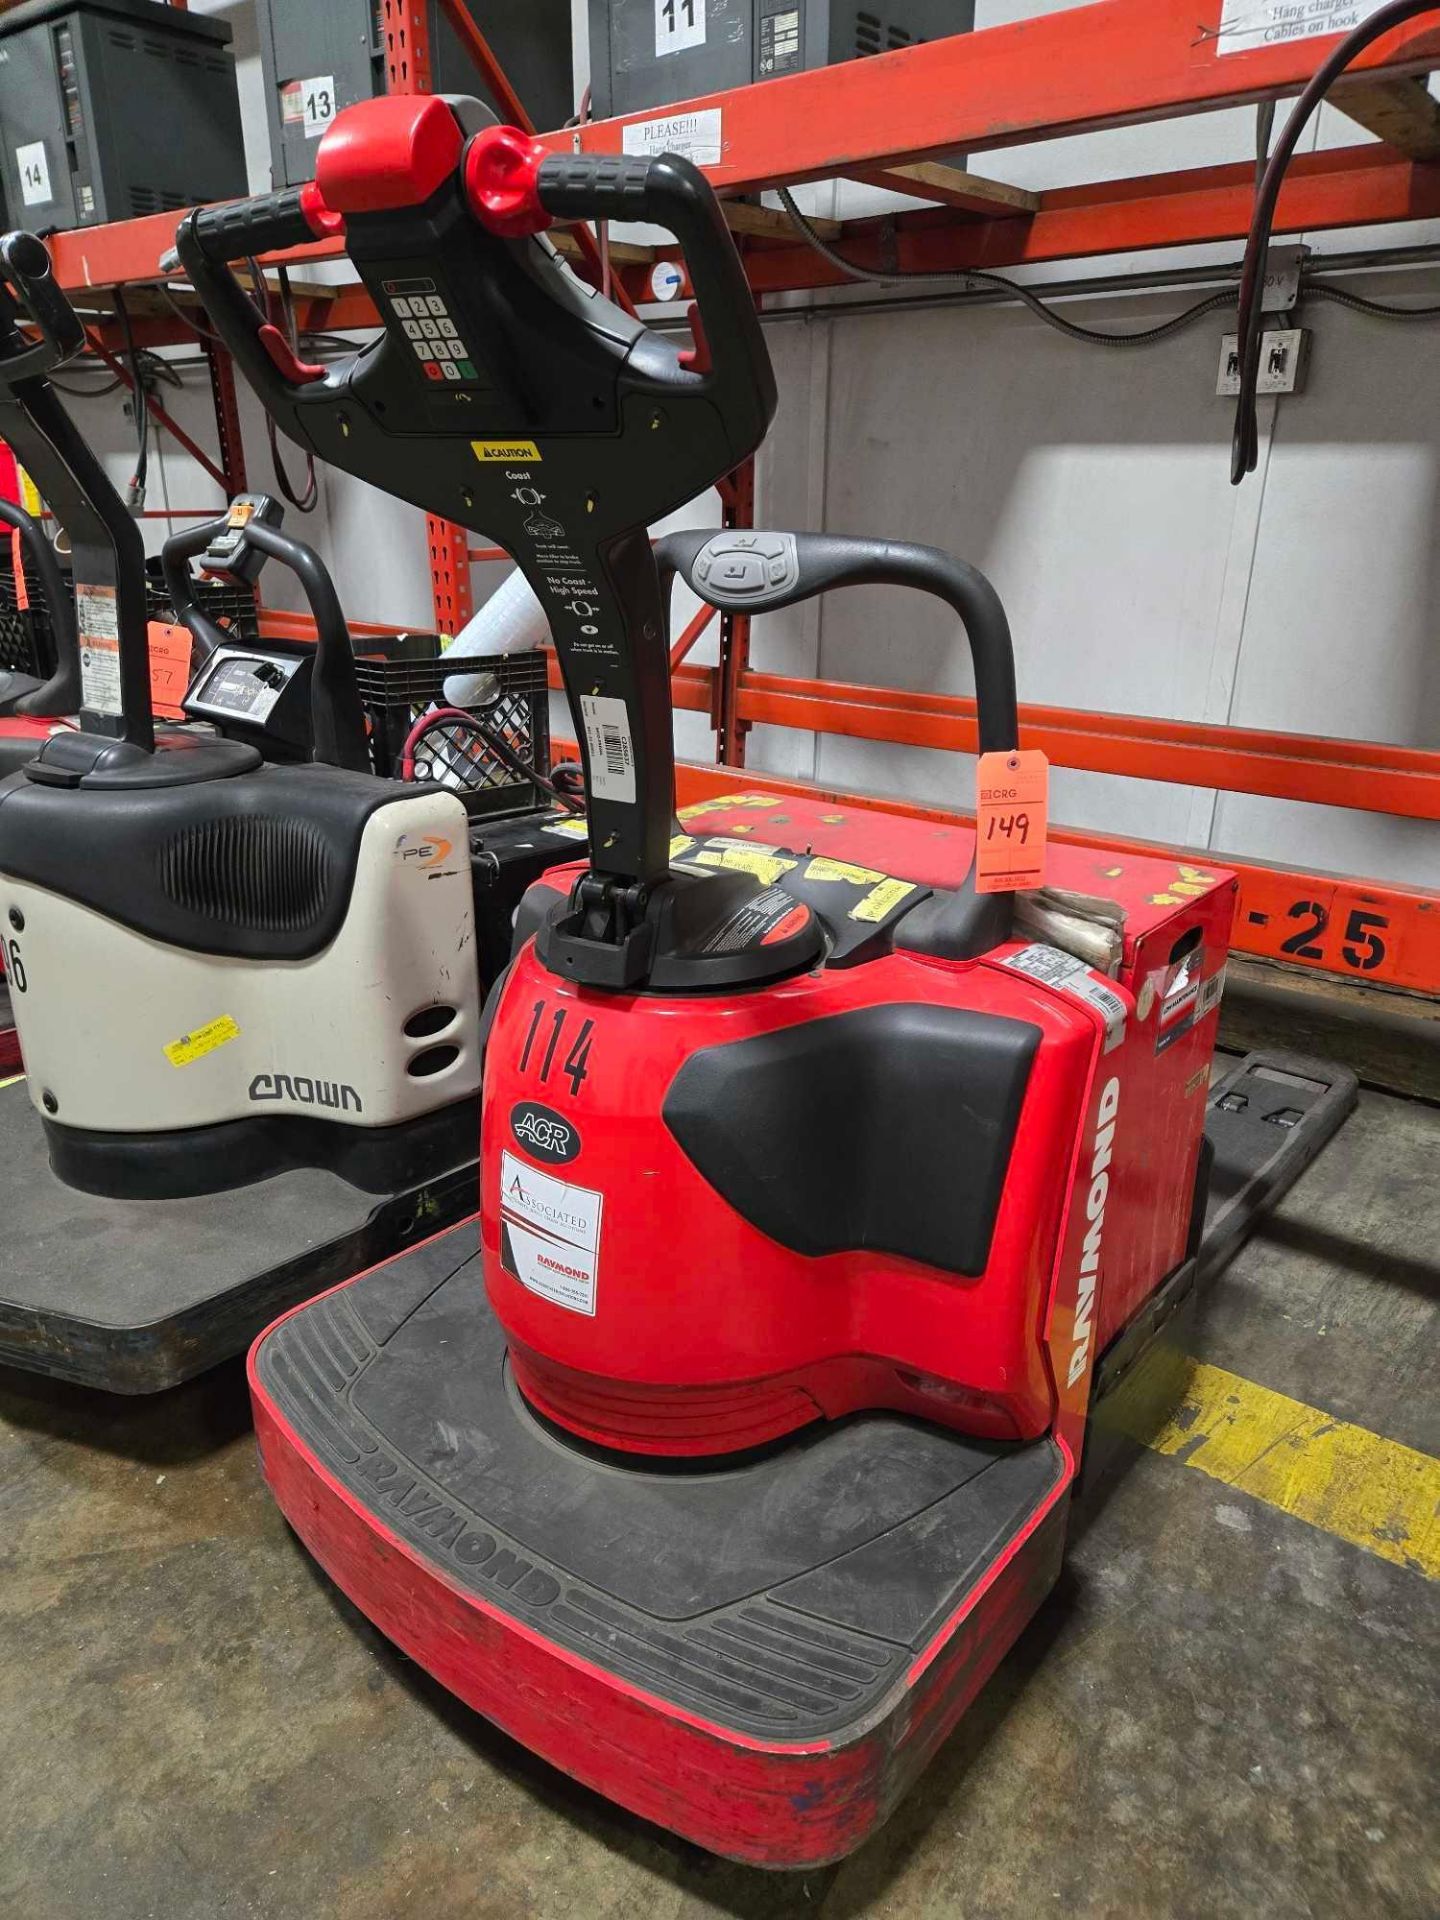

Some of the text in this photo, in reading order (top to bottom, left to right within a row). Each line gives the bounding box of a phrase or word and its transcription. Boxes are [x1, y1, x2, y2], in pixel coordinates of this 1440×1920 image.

[662, 0, 695, 33] 11
[1264, 11, 1359, 42] Cables on hook
[1272, 4, 1305, 21] Hang
[307, 91, 331, 120] 13
[644, 118, 697, 141] PLEASE!!!
[25, 163, 42, 188] 14
[490, 448, 533, 458] CAUTION
[505, 471, 531, 480] Coast
[547, 576, 560, 585] No
[562, 577, 586, 586] Coast
[550, 586, 598, 597] High Speed
[993, 788, 1018, 799] CRG
[987, 813, 1030, 845] 149
[519, 1000, 595, 1096] 114
[248, 1073, 363, 1113] CROWN
[514, 1112, 570, 1156] ACR
[1066, 1075, 1121, 1390] RAYMOND
[536, 1253, 590, 1281] RAYMOND
[355, 1455, 562, 1607] RAYMOND
